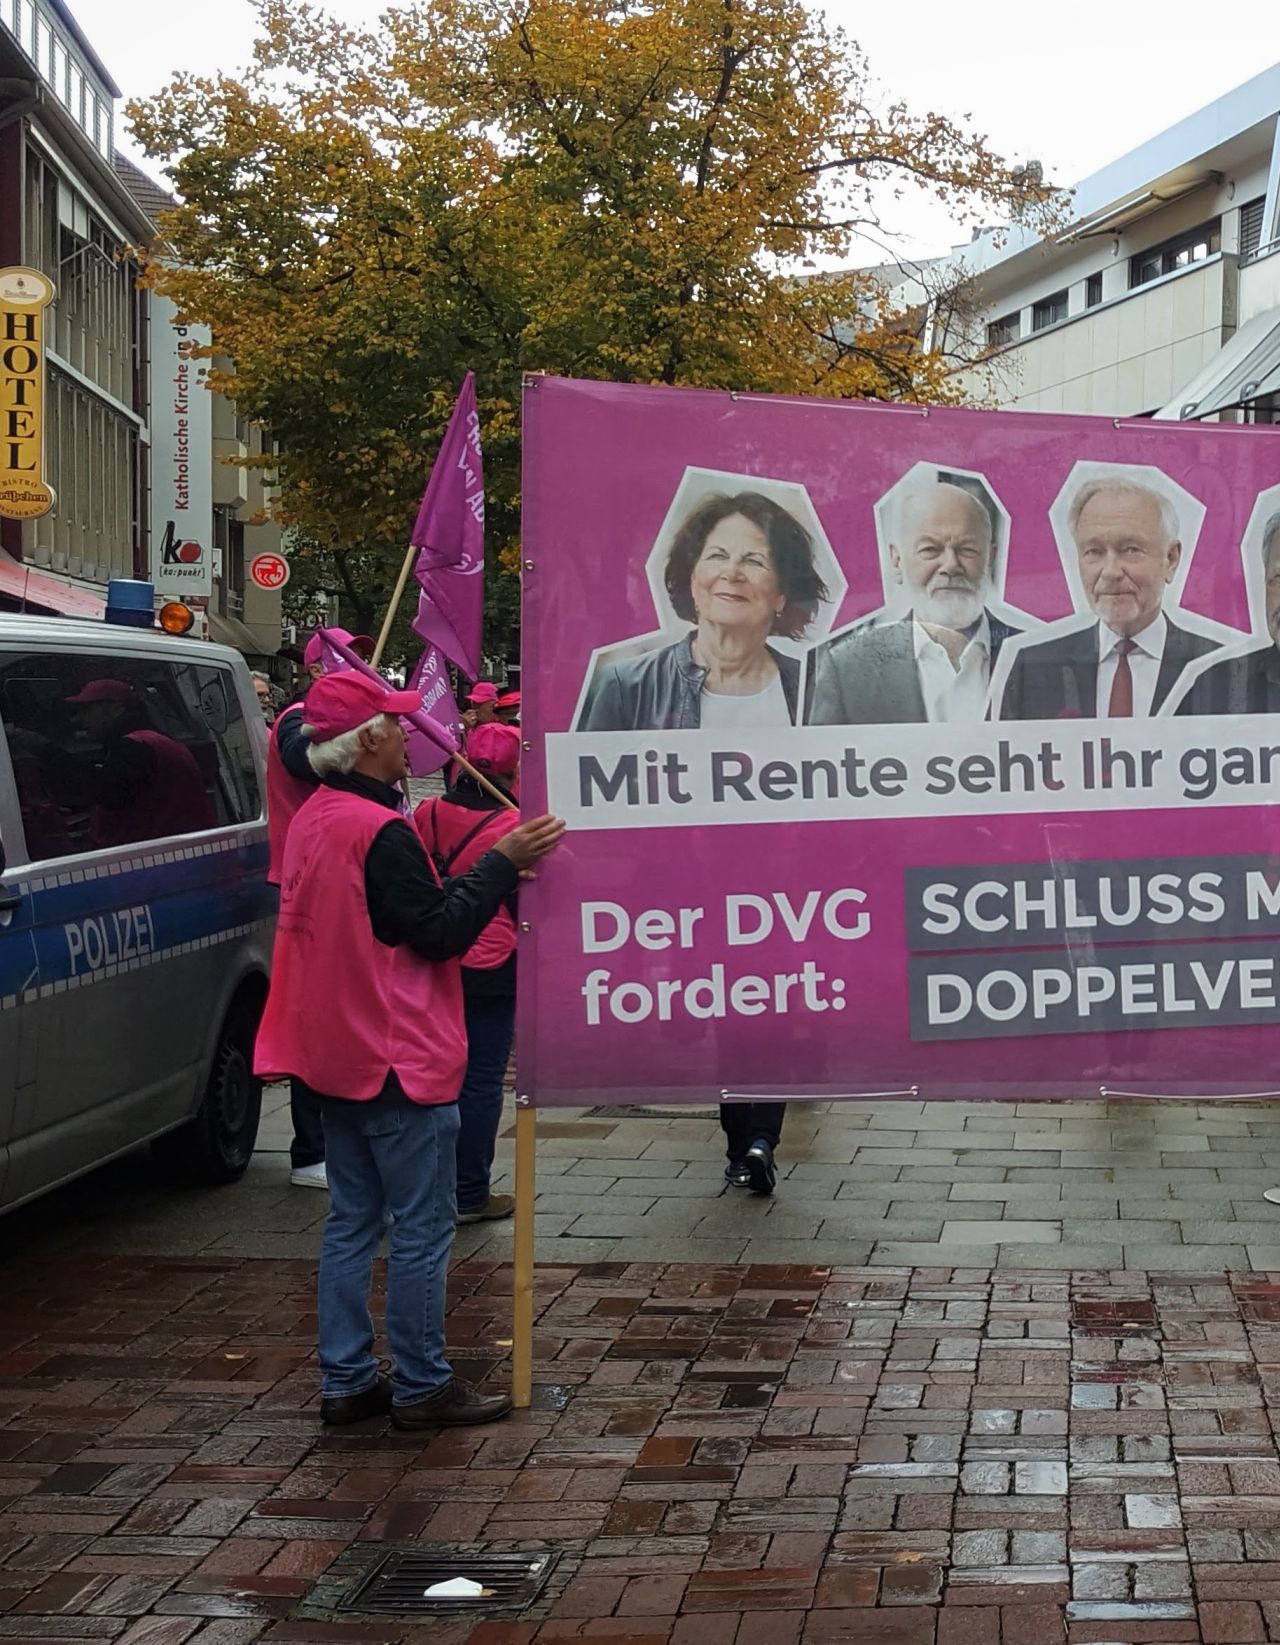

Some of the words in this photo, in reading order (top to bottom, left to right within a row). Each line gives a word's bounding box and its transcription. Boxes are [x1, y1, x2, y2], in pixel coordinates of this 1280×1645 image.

[2, 312, 38, 472] HOTEL
[173, 364, 190, 415] Kirche
[2, 478, 38, 488] BISTRO
[173, 418, 190, 510] Katholische
[0, 503, 43, 516] ESTAURANT
[578, 749, 693, 808] Mit
[710, 747, 909, 803] Rente
[924, 740, 1065, 796] seht
[1081, 736, 1163, 791] Ihr
[579, 900, 704, 954] Der
[725, 887, 872, 945] DVG
[921, 872, 1225, 937] SCHLUSS
[64, 903, 155, 976] POLIZEI
[580, 960, 847, 1026] fordert:
